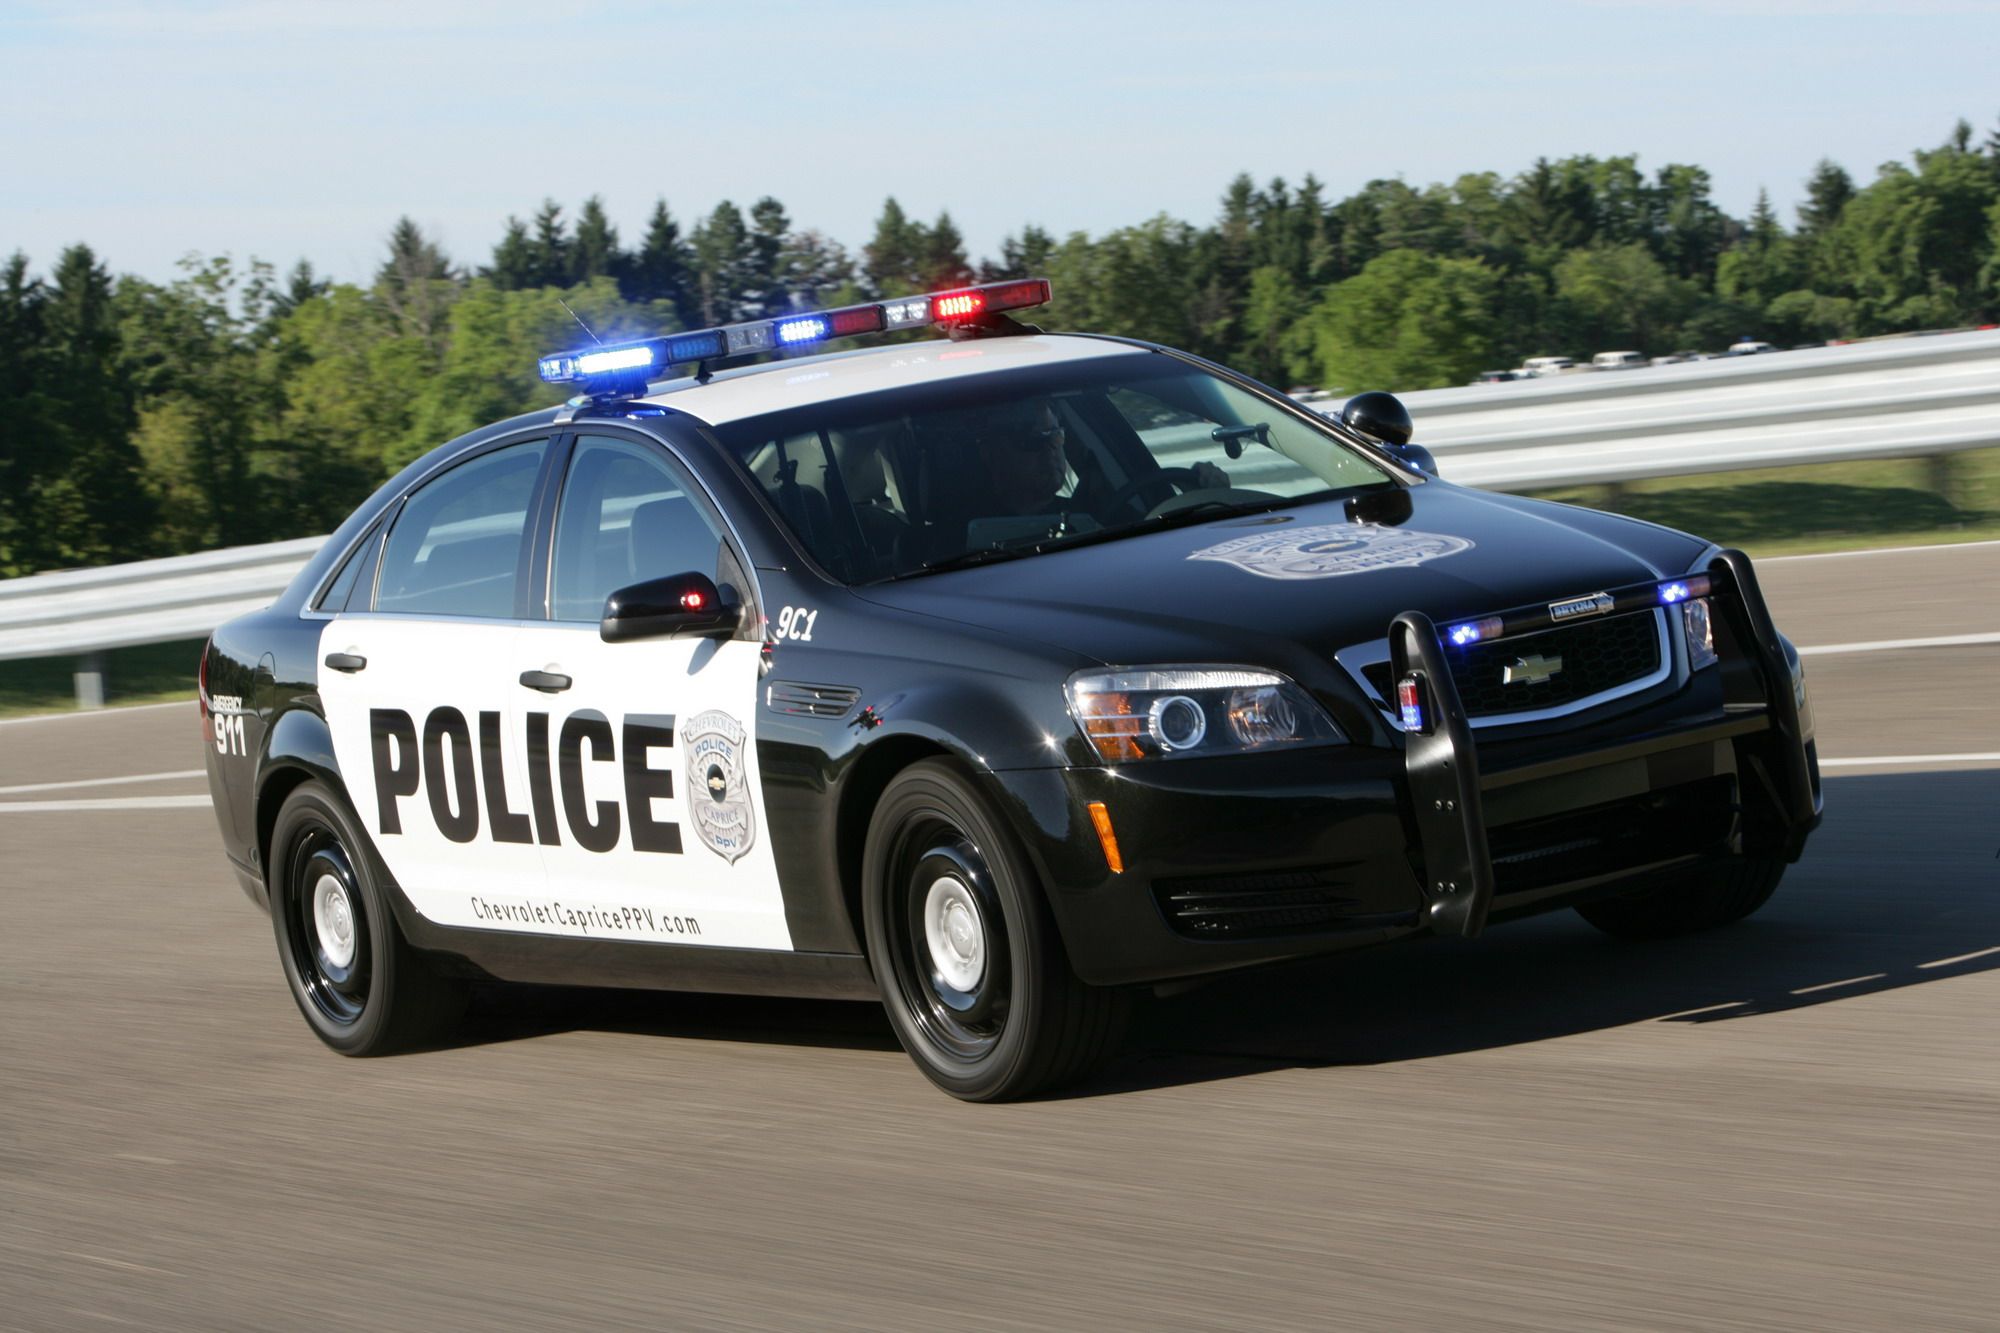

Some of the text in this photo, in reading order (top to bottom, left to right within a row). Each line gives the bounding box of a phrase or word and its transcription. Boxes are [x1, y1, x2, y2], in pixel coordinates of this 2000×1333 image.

[776, 605, 818, 642] 9C1
[214, 713, 247, 757] 911
[688, 713, 738, 739] CHEVROLET
[695, 738, 733, 759] POLICE
[369, 705, 684, 855] POLICE
[703, 805, 739, 825] CAPRICE
[715, 834, 738, 849] PPV
[471, 896, 702, 935] ChevroletCapricePPV.com
